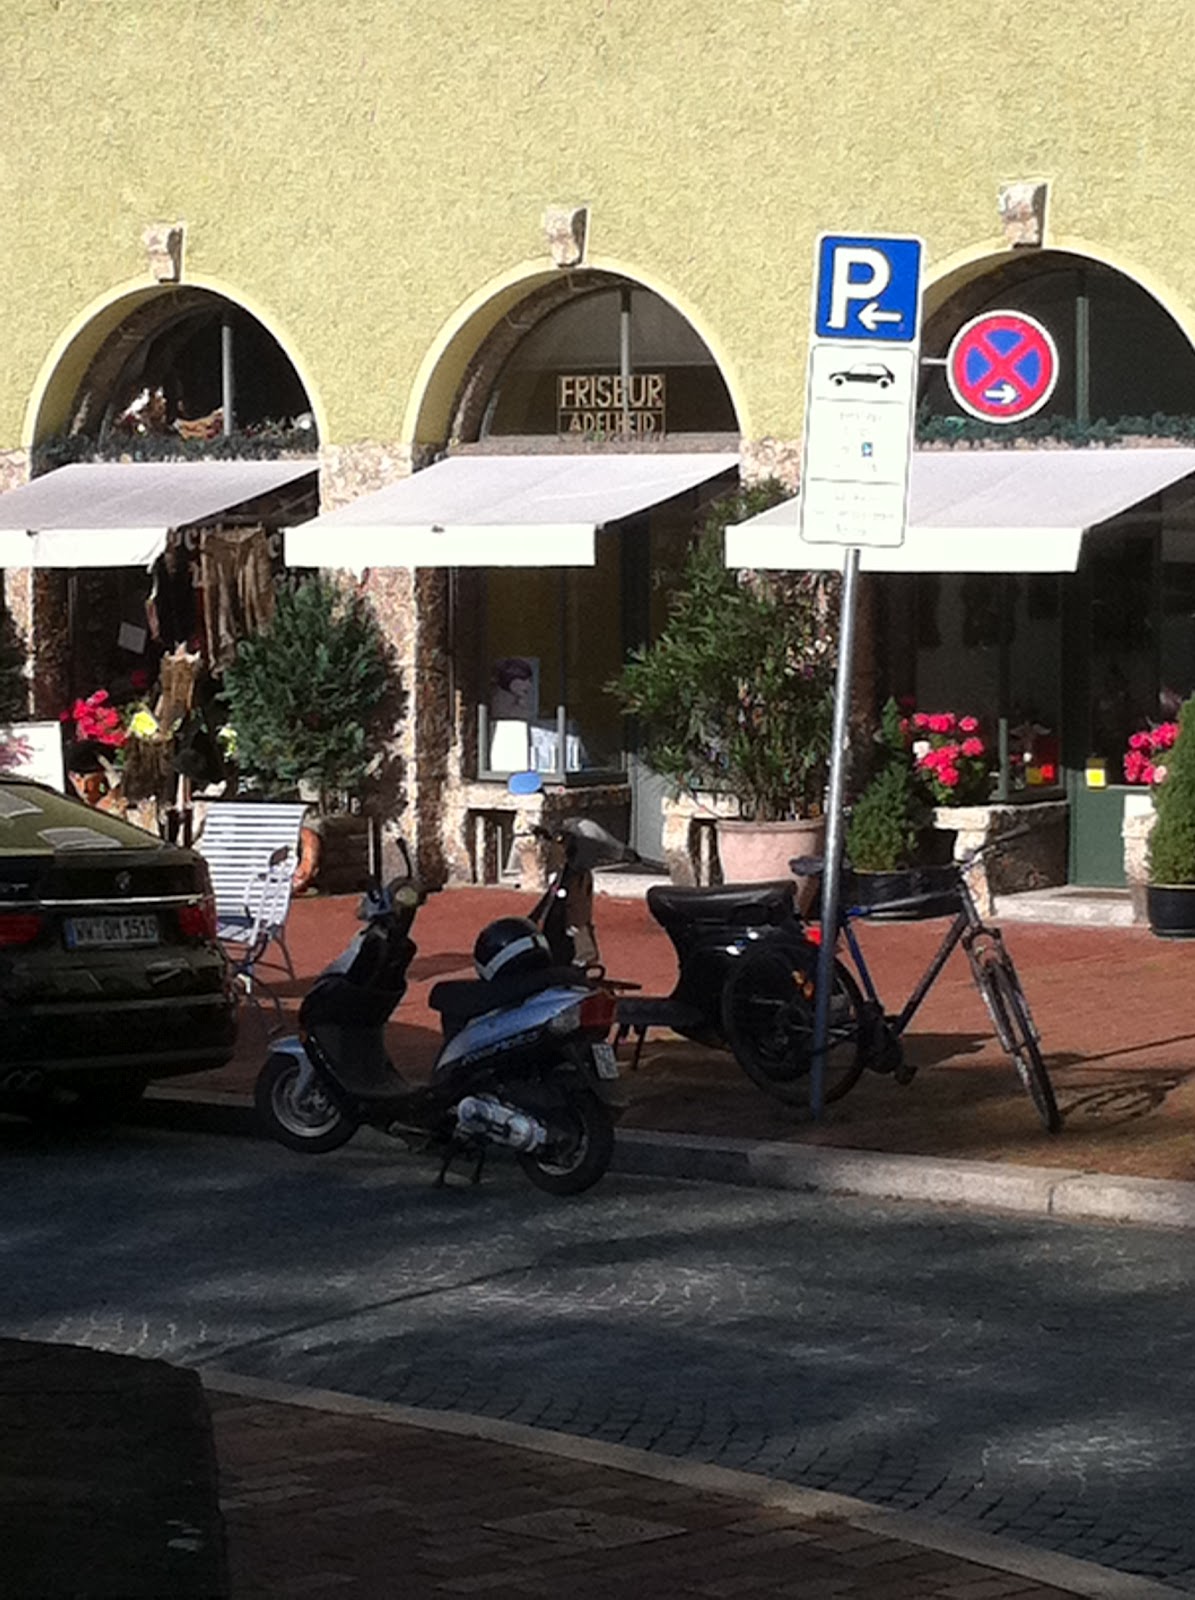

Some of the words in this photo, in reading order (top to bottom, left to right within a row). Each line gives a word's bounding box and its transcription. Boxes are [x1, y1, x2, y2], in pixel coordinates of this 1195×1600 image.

[826, 246, 891, 328] P
[561, 375, 663, 407] FRISEUR
[569, 411, 656, 434] ADELHEID
